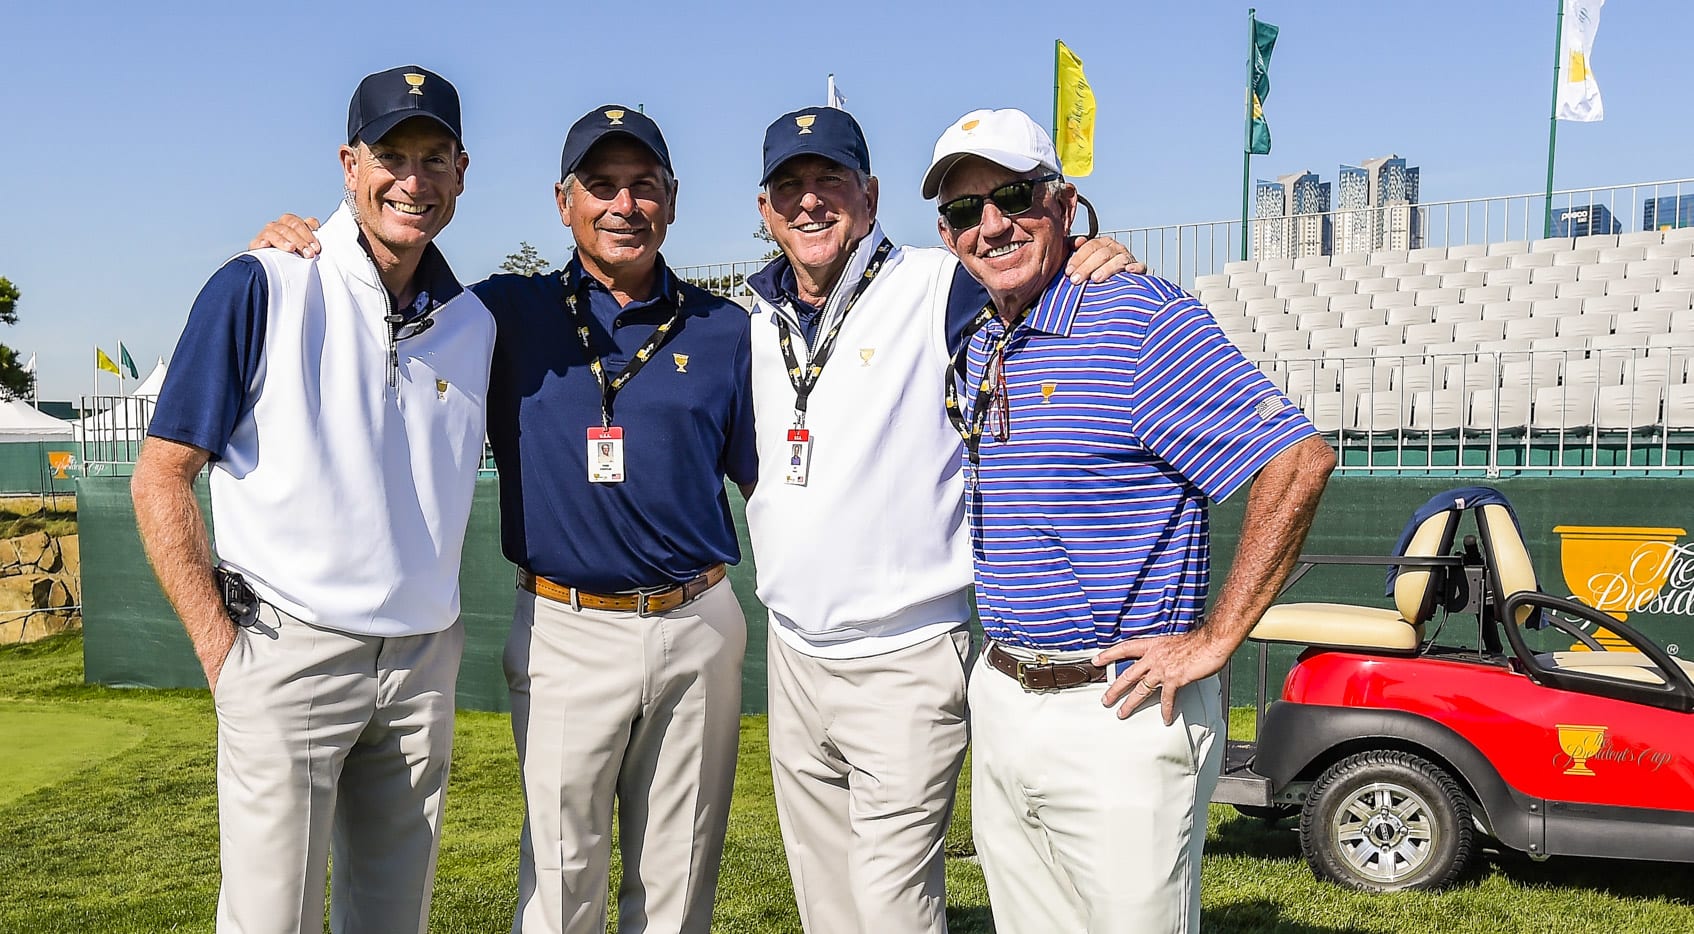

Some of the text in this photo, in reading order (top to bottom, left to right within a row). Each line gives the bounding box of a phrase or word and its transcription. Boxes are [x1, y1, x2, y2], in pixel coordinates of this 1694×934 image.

[1629, 541, 1694, 589] The
[1553, 572, 1694, 633] Presid
[1637, 747, 1672, 772] Cup
